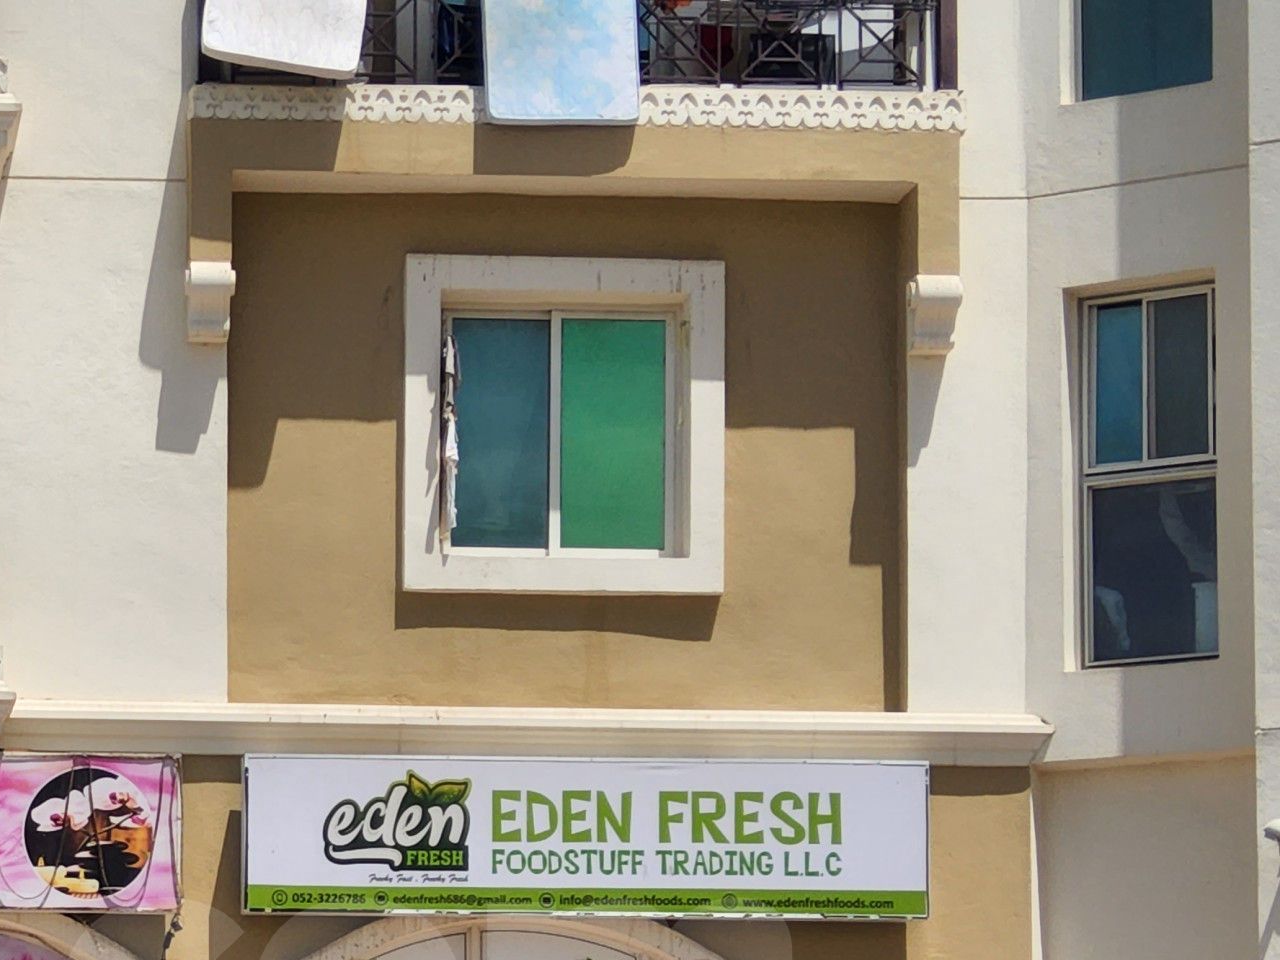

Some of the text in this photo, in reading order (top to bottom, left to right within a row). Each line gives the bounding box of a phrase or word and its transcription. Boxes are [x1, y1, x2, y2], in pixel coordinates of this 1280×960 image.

[328, 788, 467, 848] eden
[491, 789, 842, 845] EDEN FRESH
[406, 849, 464, 868] FRESH
[491, 849, 842, 877] FOODSTUFF TRADING L.L.C
[292, 893, 366, 904] 052-3226786
[559, 894, 711, 908] info@edenfreshfoods.com
[742, 896, 894, 909] www.edenfreshfoods.com
